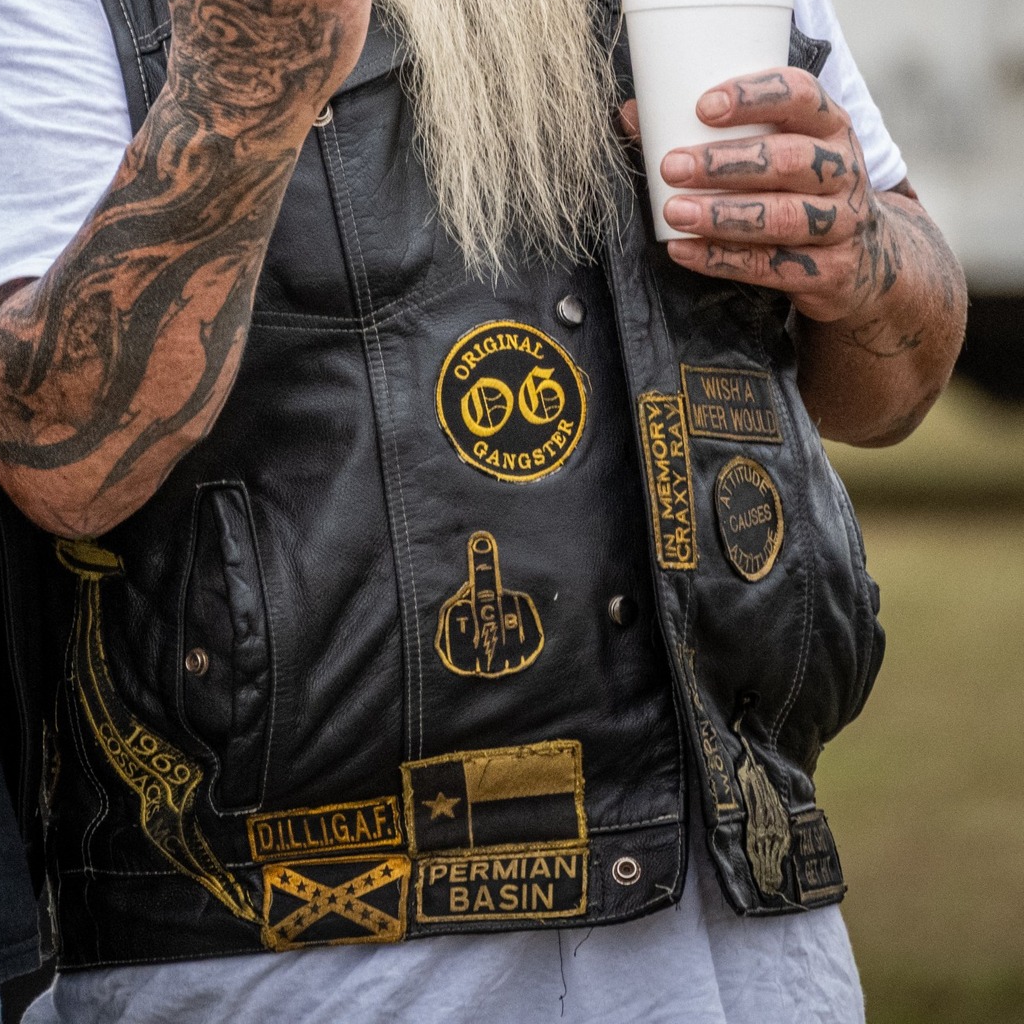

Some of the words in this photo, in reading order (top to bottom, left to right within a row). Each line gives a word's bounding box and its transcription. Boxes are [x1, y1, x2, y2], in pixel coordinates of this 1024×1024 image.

[454, 333, 544, 380] ORIGINAL
[701, 377, 739, 401] WISH
[744, 380, 755, 403] A
[729, 407, 777, 434] WOULD
[473, 419, 574, 470] GANGSTER
[720, 465, 768, 509] ATTITUDE
[729, 504, 772, 533] CAUSES
[664, 534, 677, 558] IN
[125, 723, 190, 785] 1969
[429, 855, 577, 885] PERMIAN
[449, 883, 554, 913] BASIN
